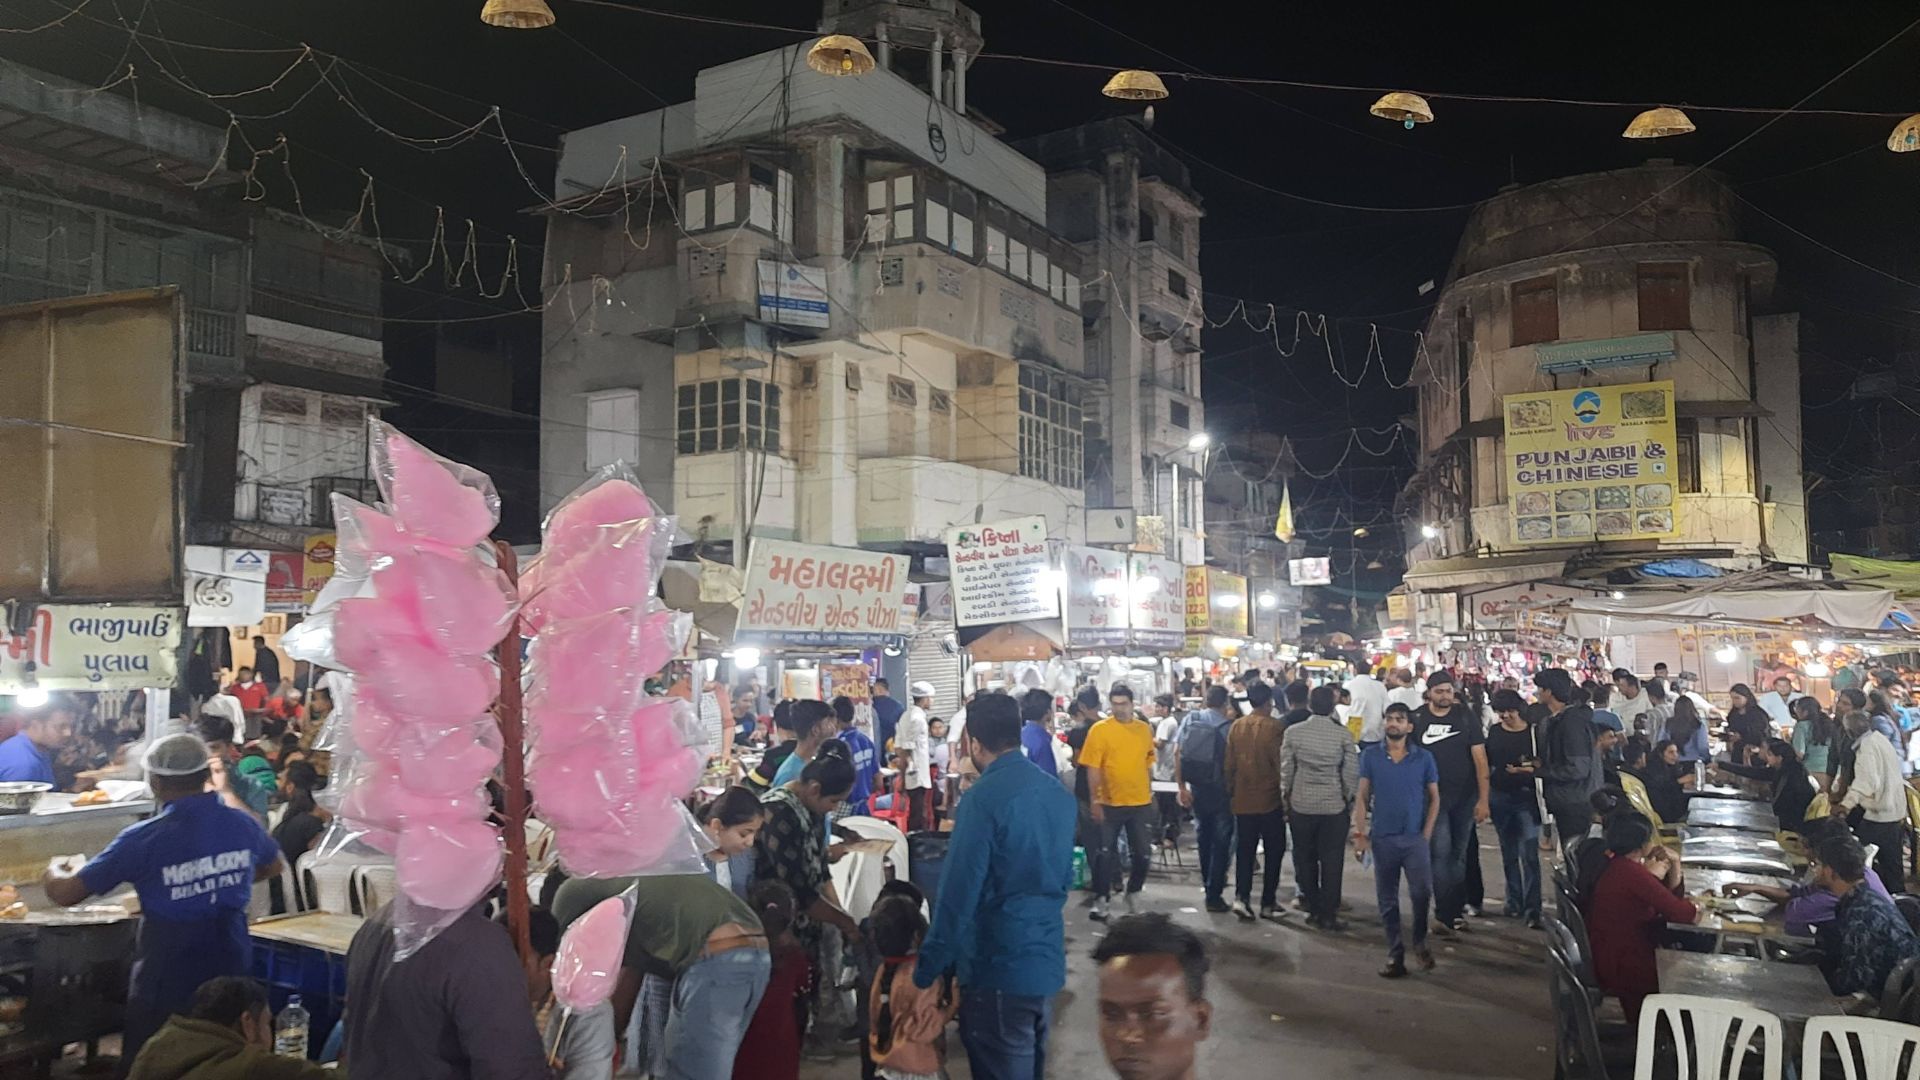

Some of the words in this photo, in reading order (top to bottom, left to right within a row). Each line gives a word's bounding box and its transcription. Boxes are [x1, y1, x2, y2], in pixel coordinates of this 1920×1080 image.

[1516, 444, 1638, 468] PUNJABI
[1643, 442, 1667, 460] &
[1516, 462, 1639, 486] CHINESE
[84, 653, 150, 683] પુલાવ
[1426, 724, 1452, 737] NIKE
[162, 849, 250, 886] MAHALAXM
[219, 872, 244, 888] PAV
